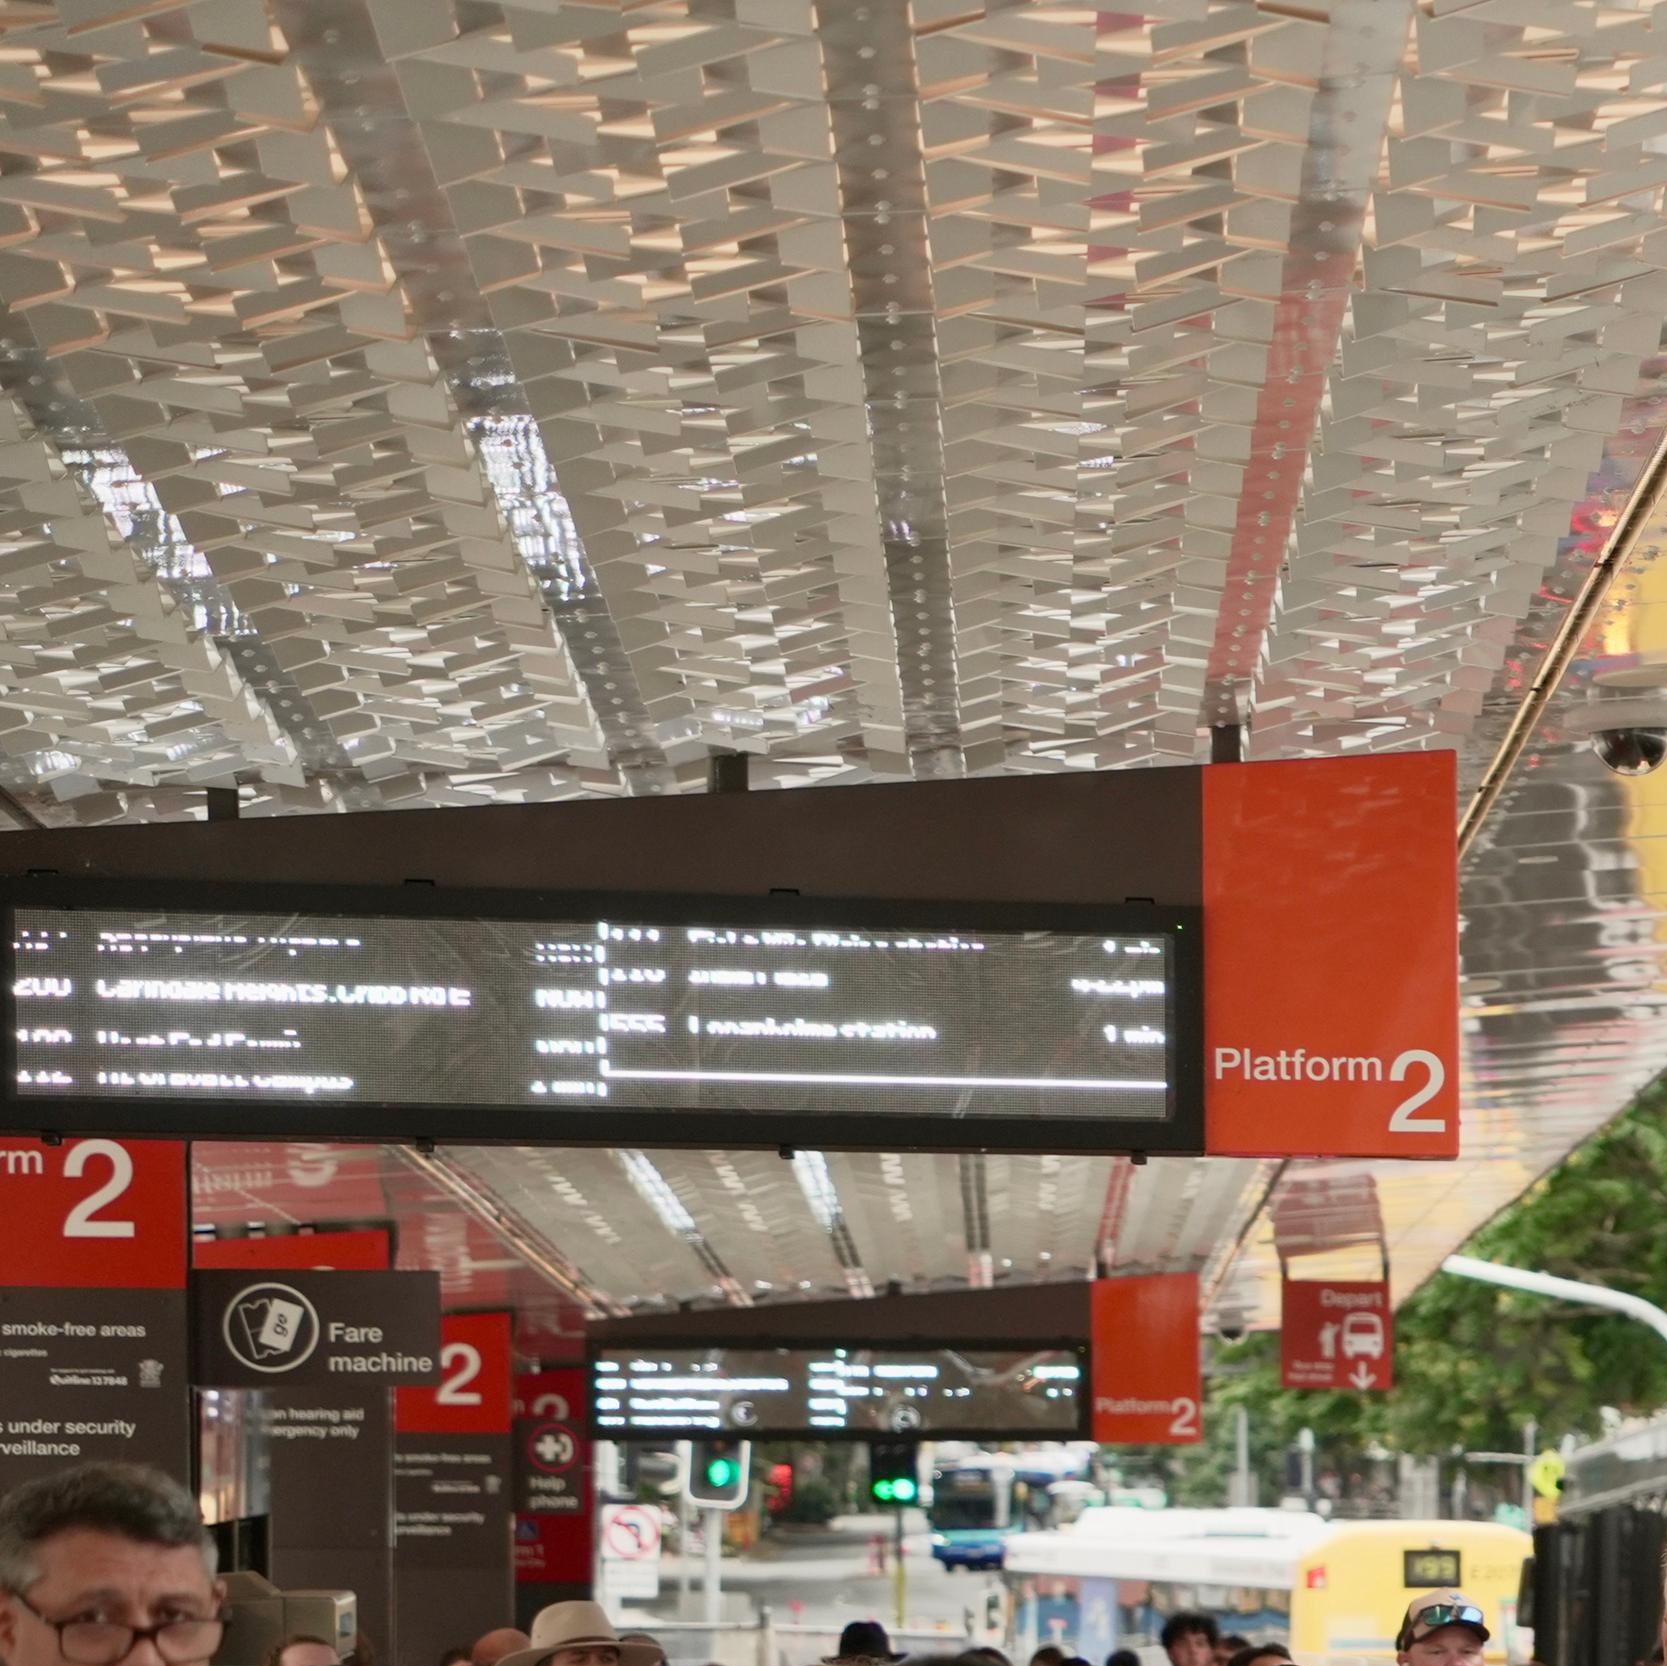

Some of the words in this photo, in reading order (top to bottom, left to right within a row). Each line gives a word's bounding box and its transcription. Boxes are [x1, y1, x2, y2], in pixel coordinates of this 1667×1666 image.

[1215, 1046, 1382, 1082] Platform
[1389, 1050, 1446, 1132] 2
[62, 1139, 135, 1238] 2
[1321, 1289, 1383, 1309] Depart
[2, 1321, 96, 1337] smoke-free
[100, 1324, 146, 1337] areas
[328, 1322, 383, 1343] Fare
[328, 1352, 432, 1373] machine
[436, 1343, 482, 1406] 2
[289, 1408, 340, 1423] hearing
[342, 1408, 364, 1421] aid
[1095, 1397, 1169, 1415] Platform
[1169, 1397, 1197, 1437] 2
[8, 1419, 61, 1434] under
[65, 1419, 136, 1438] security
